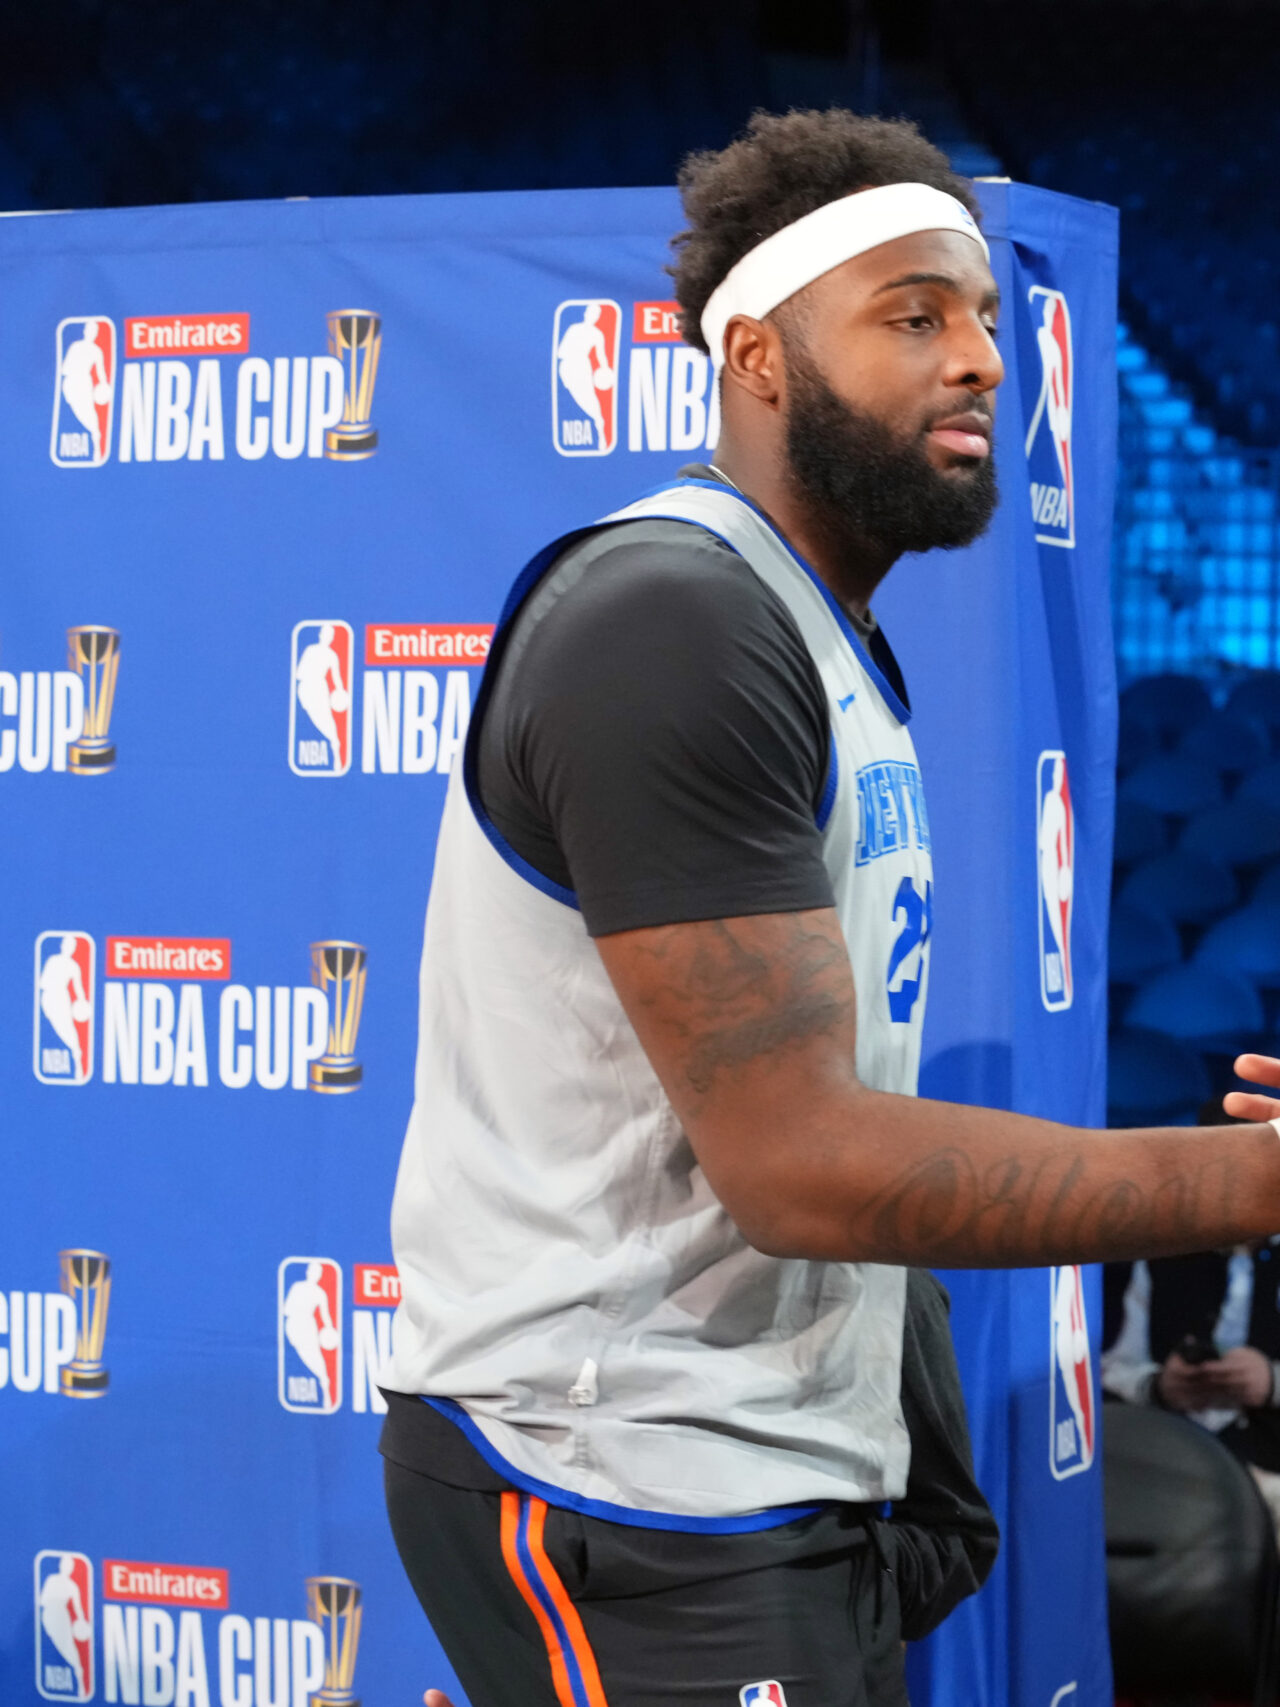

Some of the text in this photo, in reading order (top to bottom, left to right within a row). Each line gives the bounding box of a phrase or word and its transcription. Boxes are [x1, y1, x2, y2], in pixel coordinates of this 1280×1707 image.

[133, 321, 242, 349] Emirates
[119, 357, 344, 462] NBA CUP
[60, 432, 90, 458] NBA
[563, 420, 593, 446] NBA
[1029, 482, 1067, 529] NBA
[374, 629, 491, 657] Emirates
[362, 670, 473, 774] NBA
[299, 740, 329, 766] NBA
[114, 941, 224, 972] Emirates
[103, 982, 329, 1090] NBA CUP
[0, 1290, 77, 1394] UP
[111, 1565, 222, 1600] Emirates
[103, 1604, 325, 1707] NBA CUP
